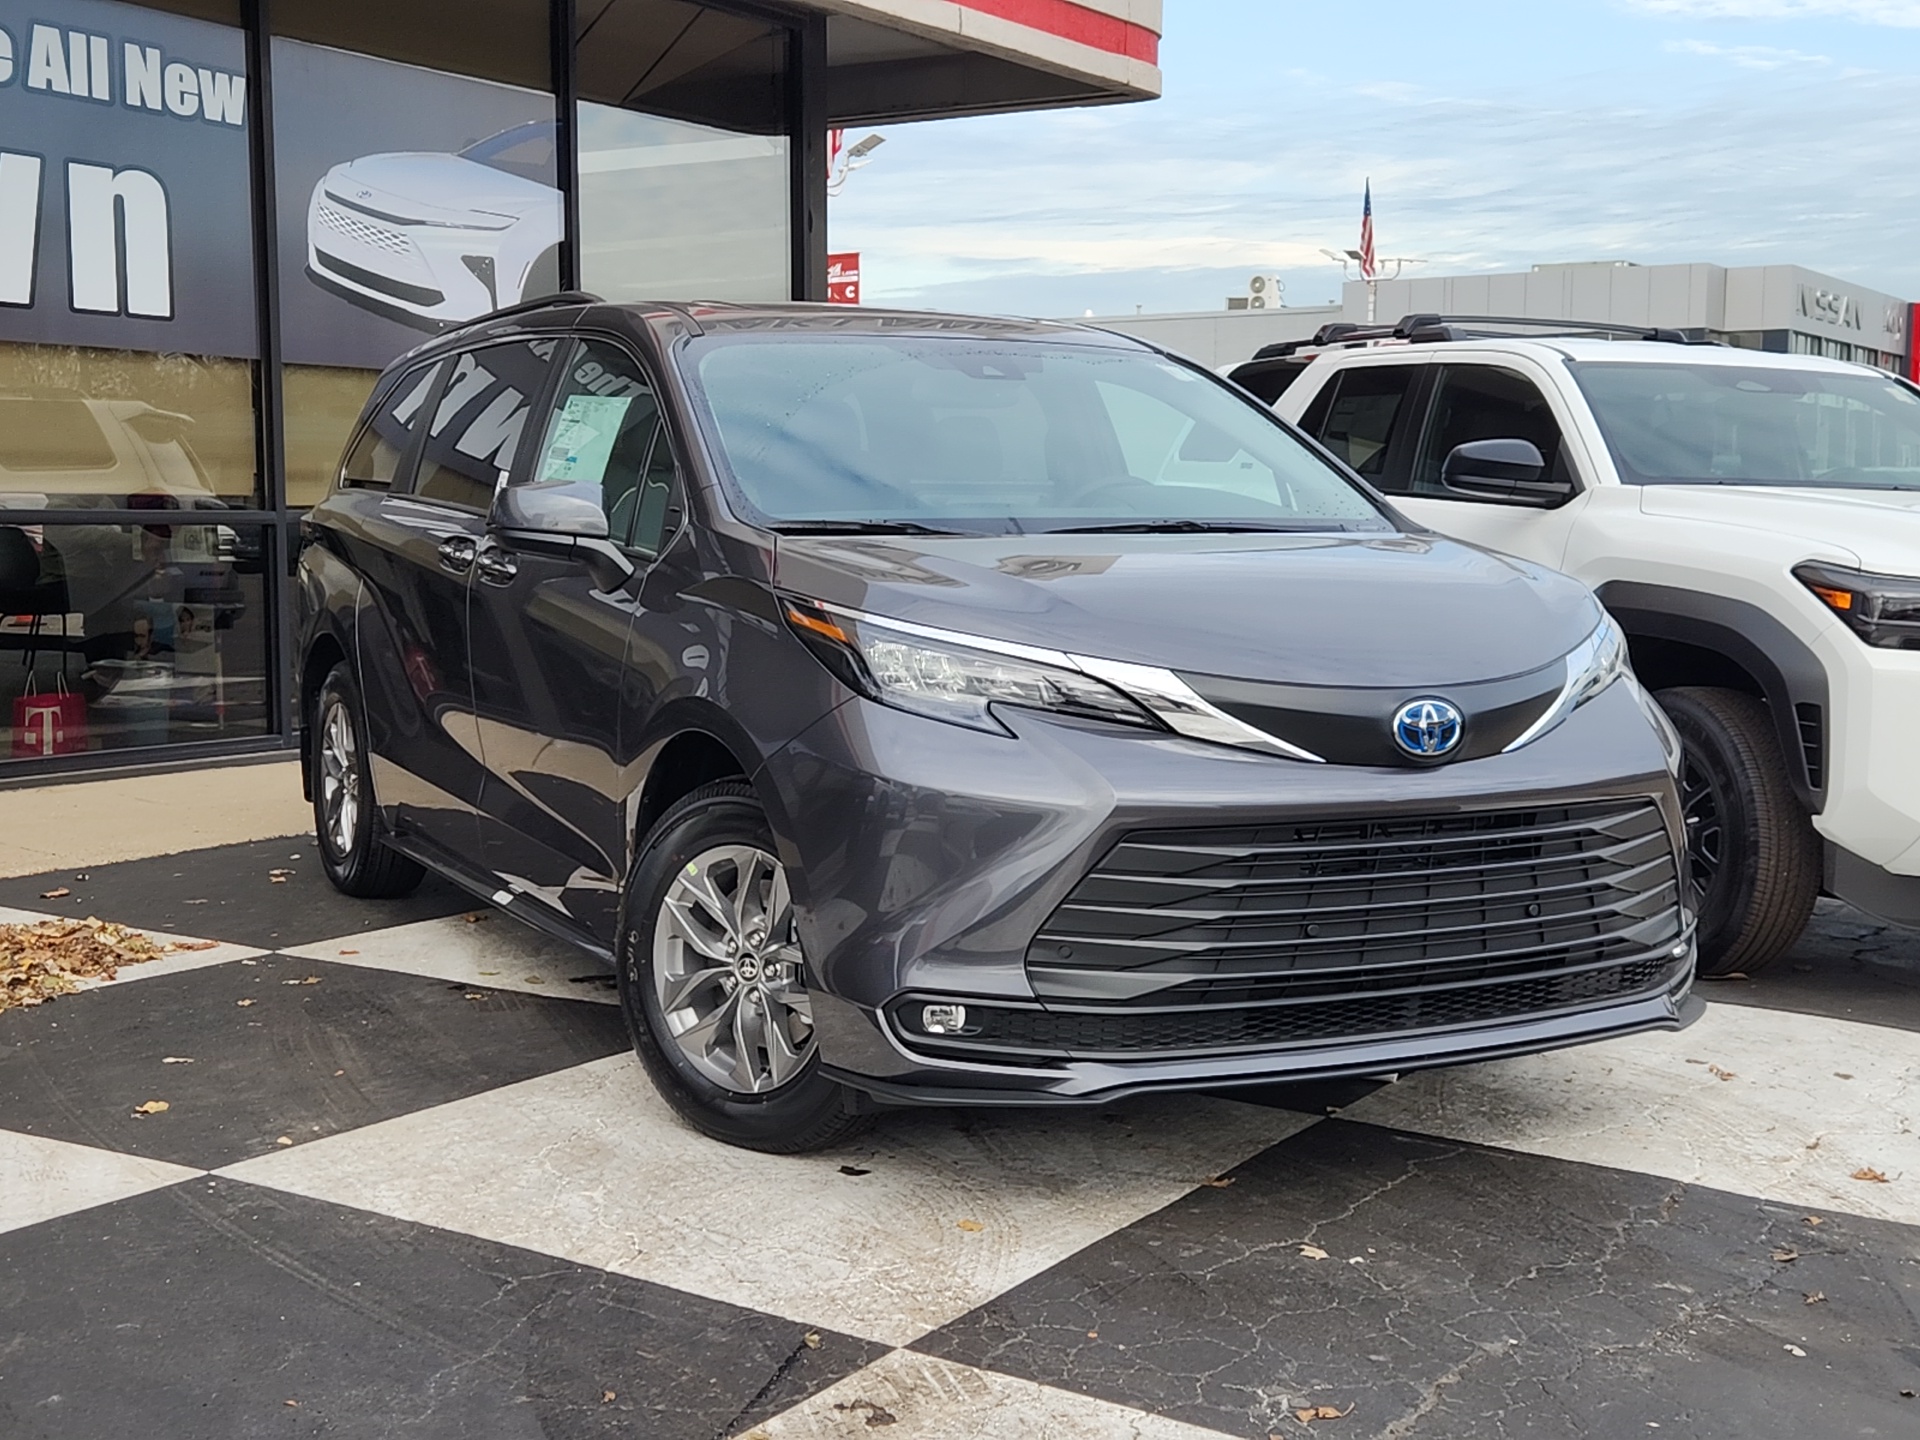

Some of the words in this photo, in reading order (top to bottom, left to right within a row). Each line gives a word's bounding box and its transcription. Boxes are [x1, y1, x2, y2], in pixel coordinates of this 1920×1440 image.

[28, 24, 110, 101] All
[124, 42, 246, 126] New
[1797, 283, 1863, 331] NISSAN
